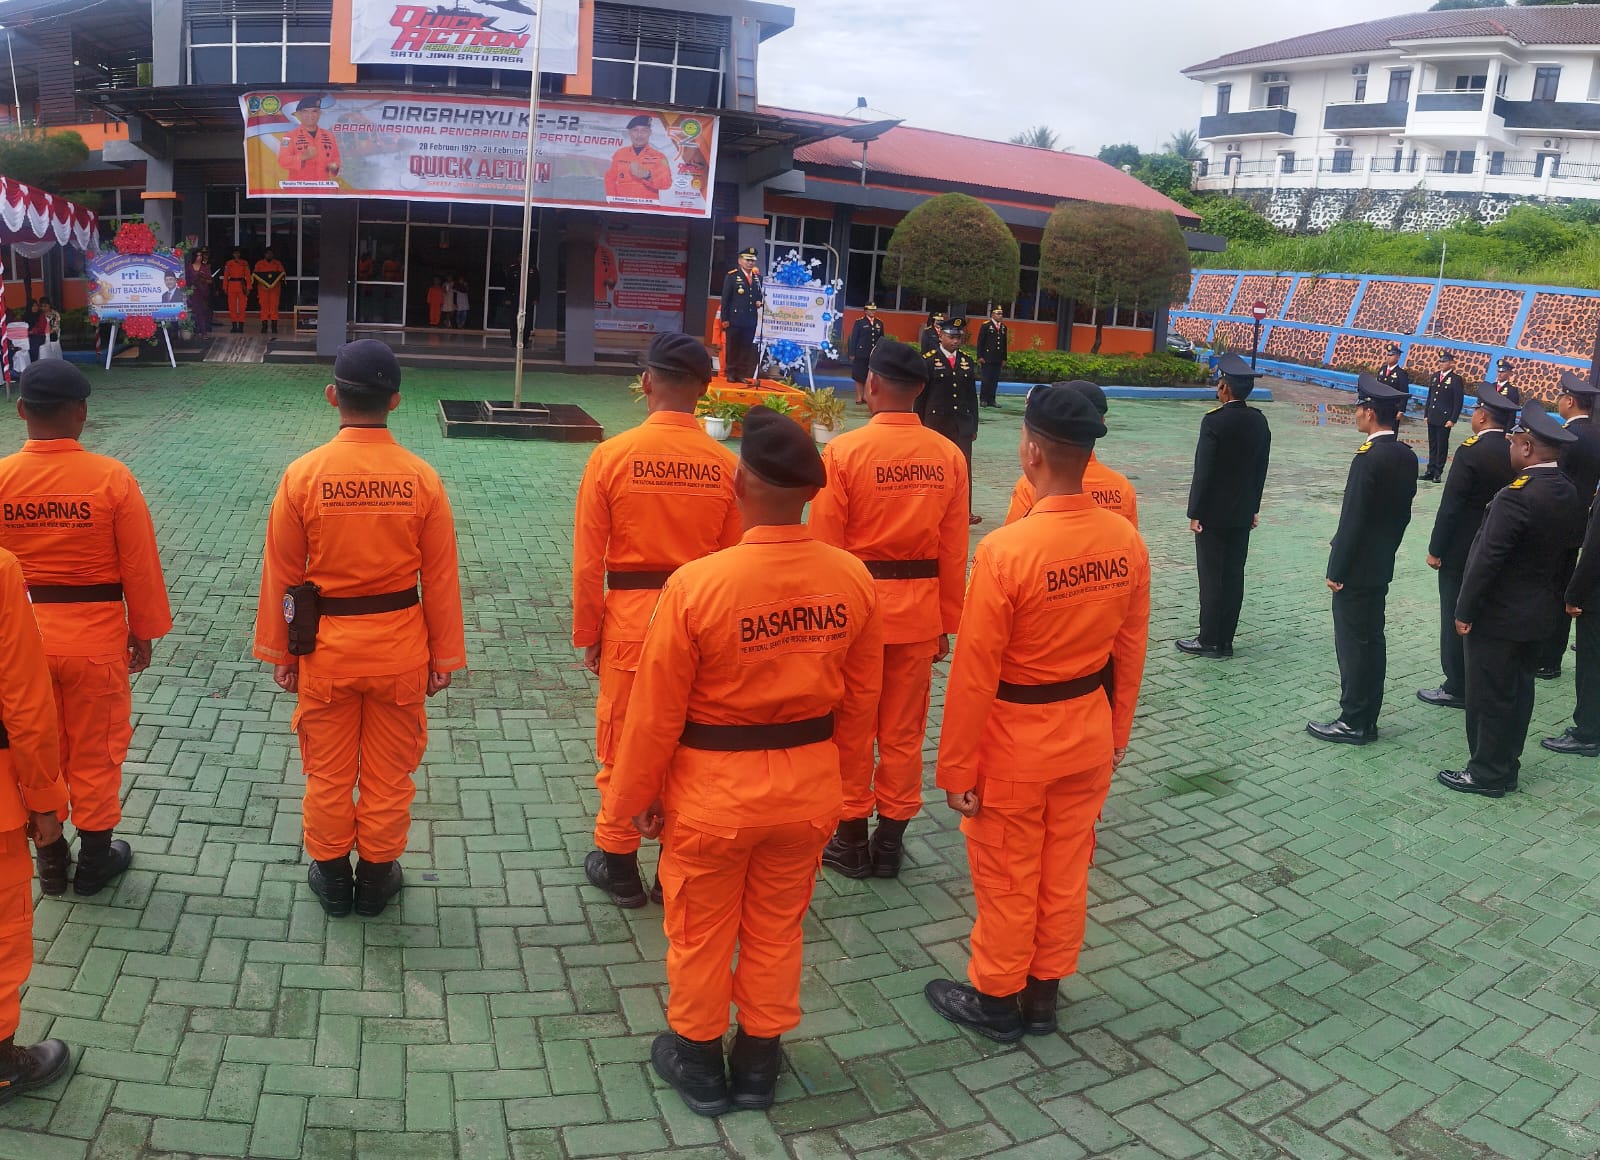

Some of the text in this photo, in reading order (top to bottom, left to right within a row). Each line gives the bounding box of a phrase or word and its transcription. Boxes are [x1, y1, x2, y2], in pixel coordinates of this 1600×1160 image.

[389, 5, 488, 30] QUICK
[391, 27, 531, 51] ACTION
[390, 50, 422, 59] SATU
[457, 53, 489, 61] SATU
[492, 55, 524, 63] RASA
[382, 105, 514, 127] DIRGAHAYU
[333, 123, 374, 133] BADAN
[376, 124, 437, 135] NASIONAL
[440, 127, 509, 140] PENCARIAN
[539, 132, 624, 147] PERTOLONGAN
[418, 142, 428, 150] 28
[429, 142, 459, 151] Februari
[461, 144, 476, 152] 1972
[483, 145, 491, 153] 28
[493, 146, 524, 155] Februari
[409, 154, 473, 180] QUICK
[633, 460, 721, 481] BASARNAS
[876, 464, 945, 484] BASARNAS
[322, 480, 413, 499] BASARNAS
[1091, 489, 1122, 504] RNAS
[3, 501, 91, 521] BASARNAS
[1046, 556, 1129, 592] BASARNAS
[741, 603, 848, 642] BASARNAS
